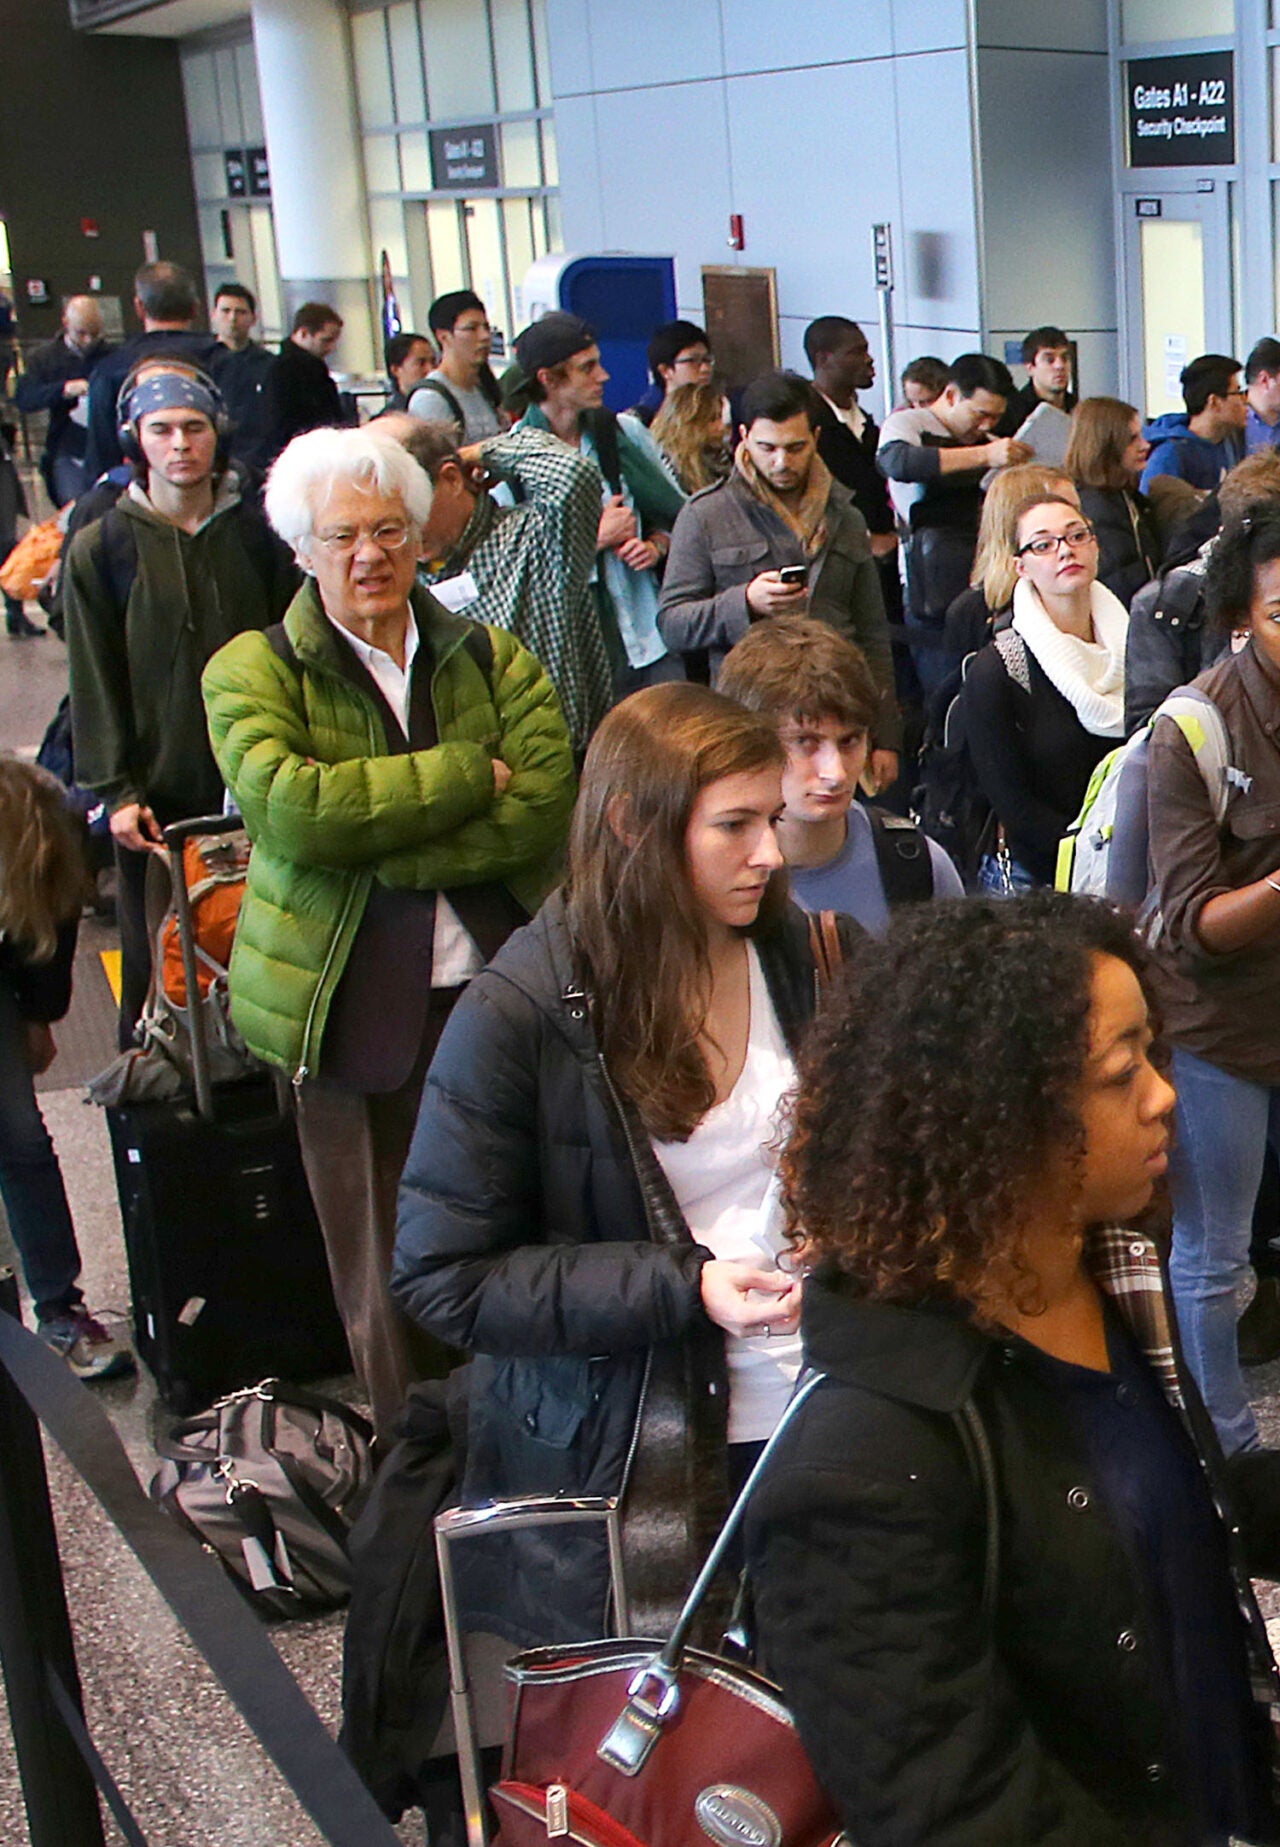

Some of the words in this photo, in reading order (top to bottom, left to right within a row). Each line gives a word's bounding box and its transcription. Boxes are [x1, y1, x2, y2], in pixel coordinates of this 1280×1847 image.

[1134, 85, 1171, 110] Gates
[1172, 82, 1188, 108] A1
[1198, 80, 1226, 106] A22
[1136, 118, 1173, 140] Security
[1173, 115, 1227, 139] Checkpoint
